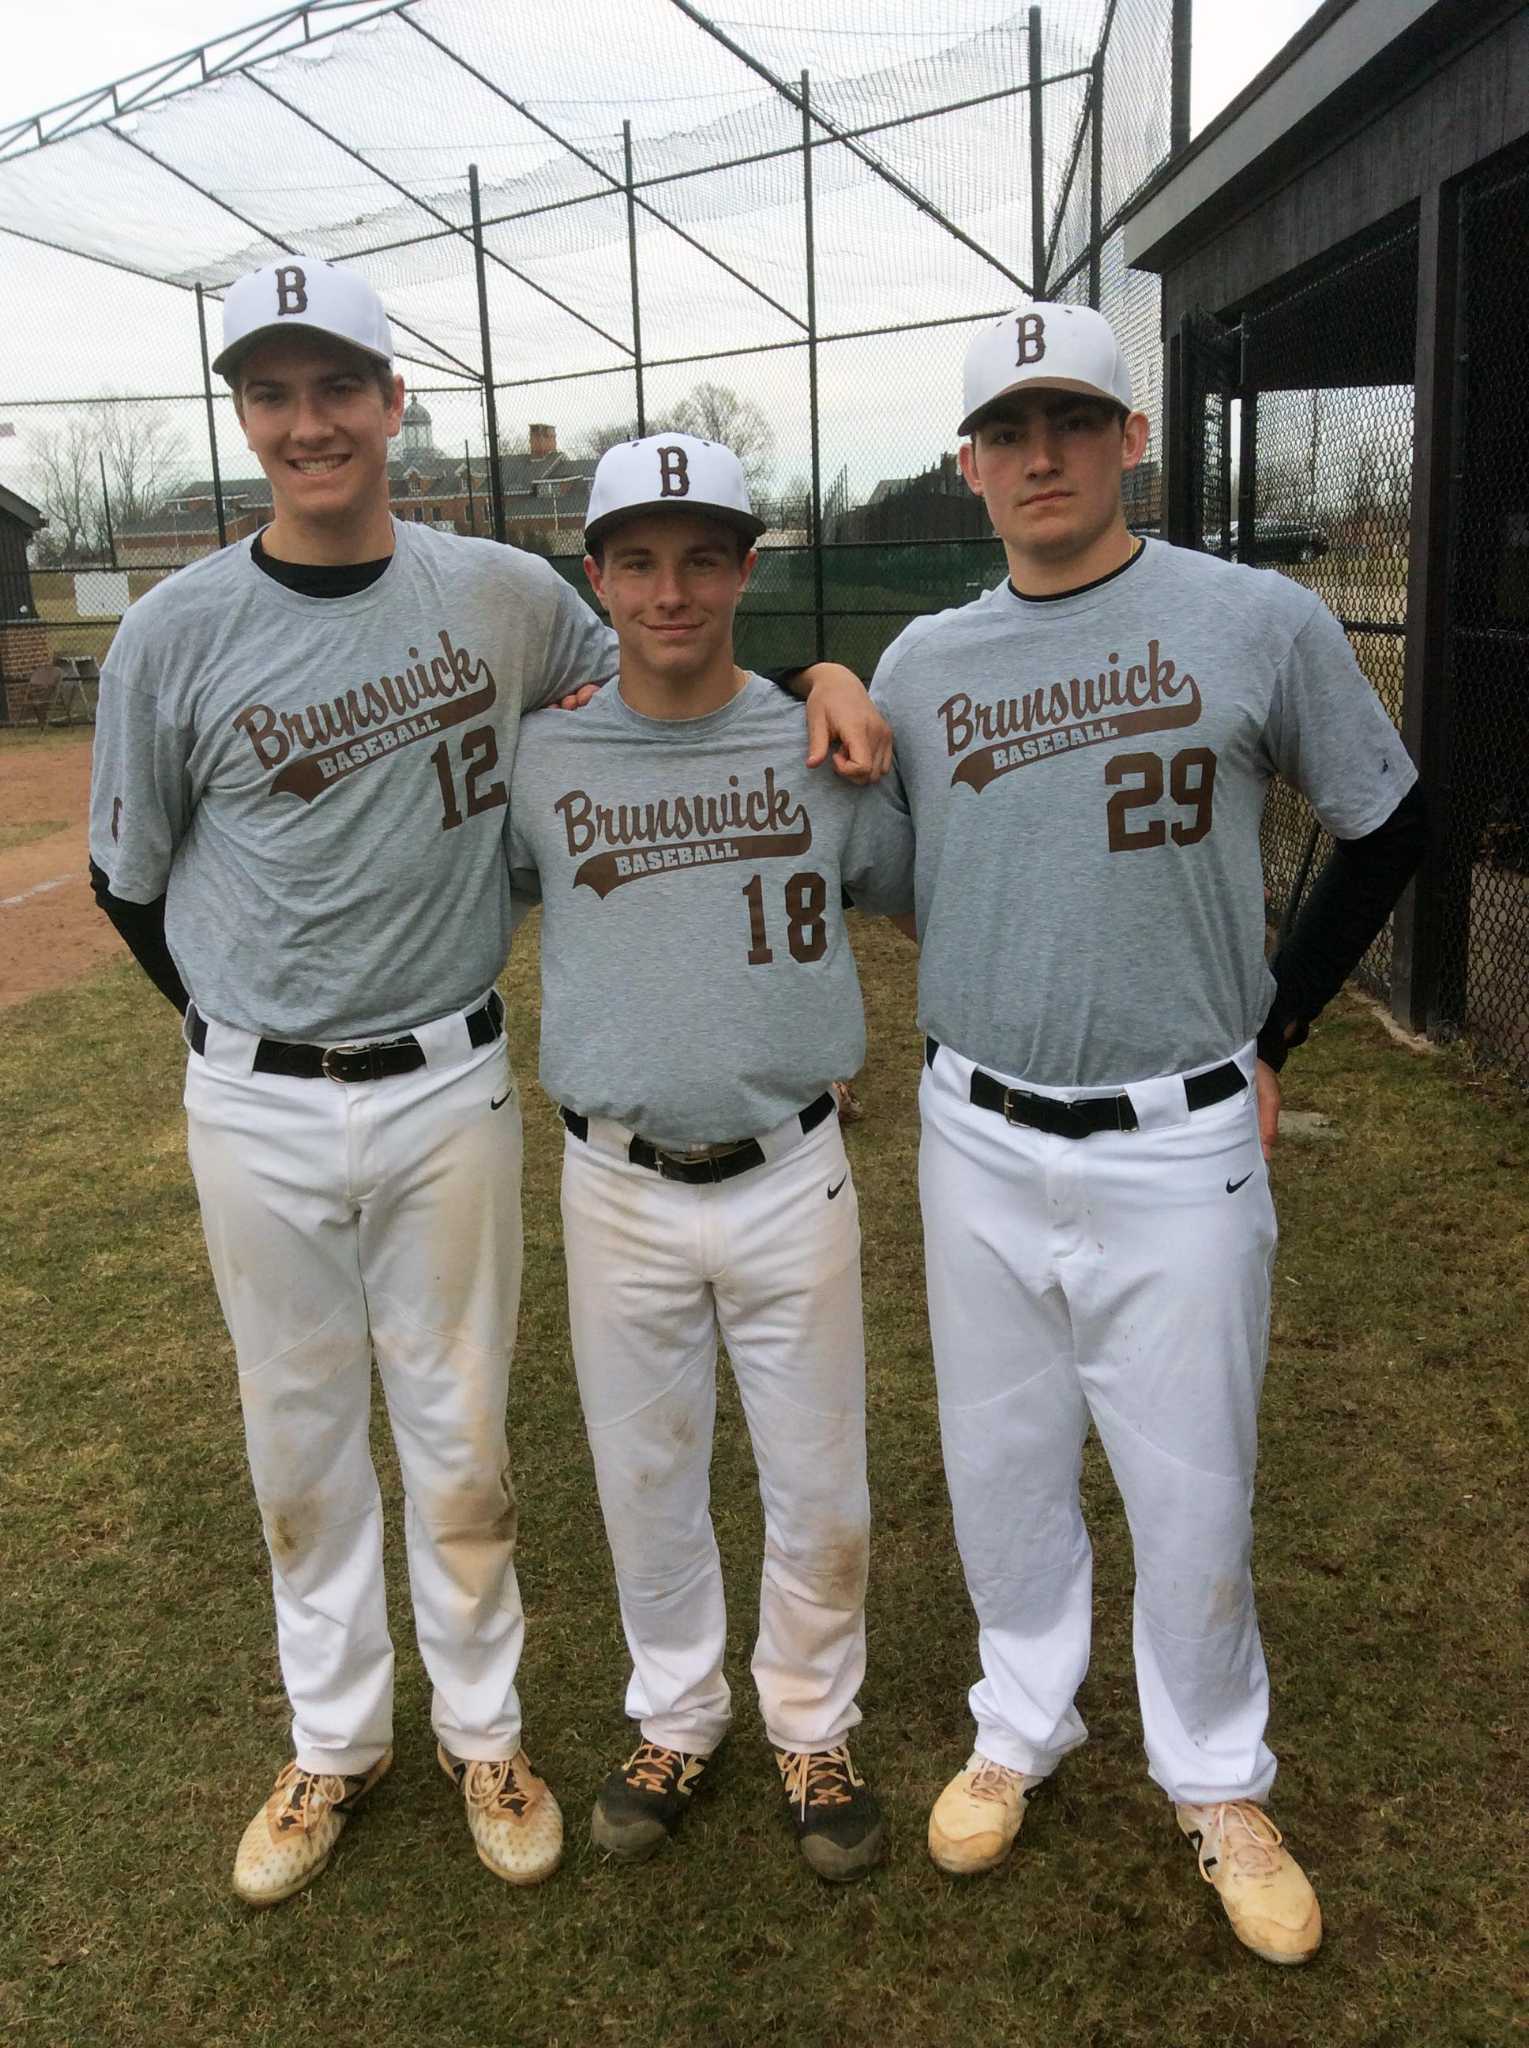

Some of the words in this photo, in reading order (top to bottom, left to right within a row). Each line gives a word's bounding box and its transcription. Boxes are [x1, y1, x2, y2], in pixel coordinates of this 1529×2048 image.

[275, 265, 308, 316] B
[1015, 313, 1046, 367] B
[657, 446, 690, 497] B
[232, 630, 495, 770] Brunswick
[937, 639, 1202, 757] Brunswick
[317, 715, 440, 779] BASEBALL
[430, 724, 508, 832] 12
[992, 721, 1119, 770] BASEBALL
[554, 767, 812, 857] Brunswick
[1104, 747, 1217, 853] 29
[614, 842, 739, 877] BASEBALL
[742, 872, 828, 965] 18
